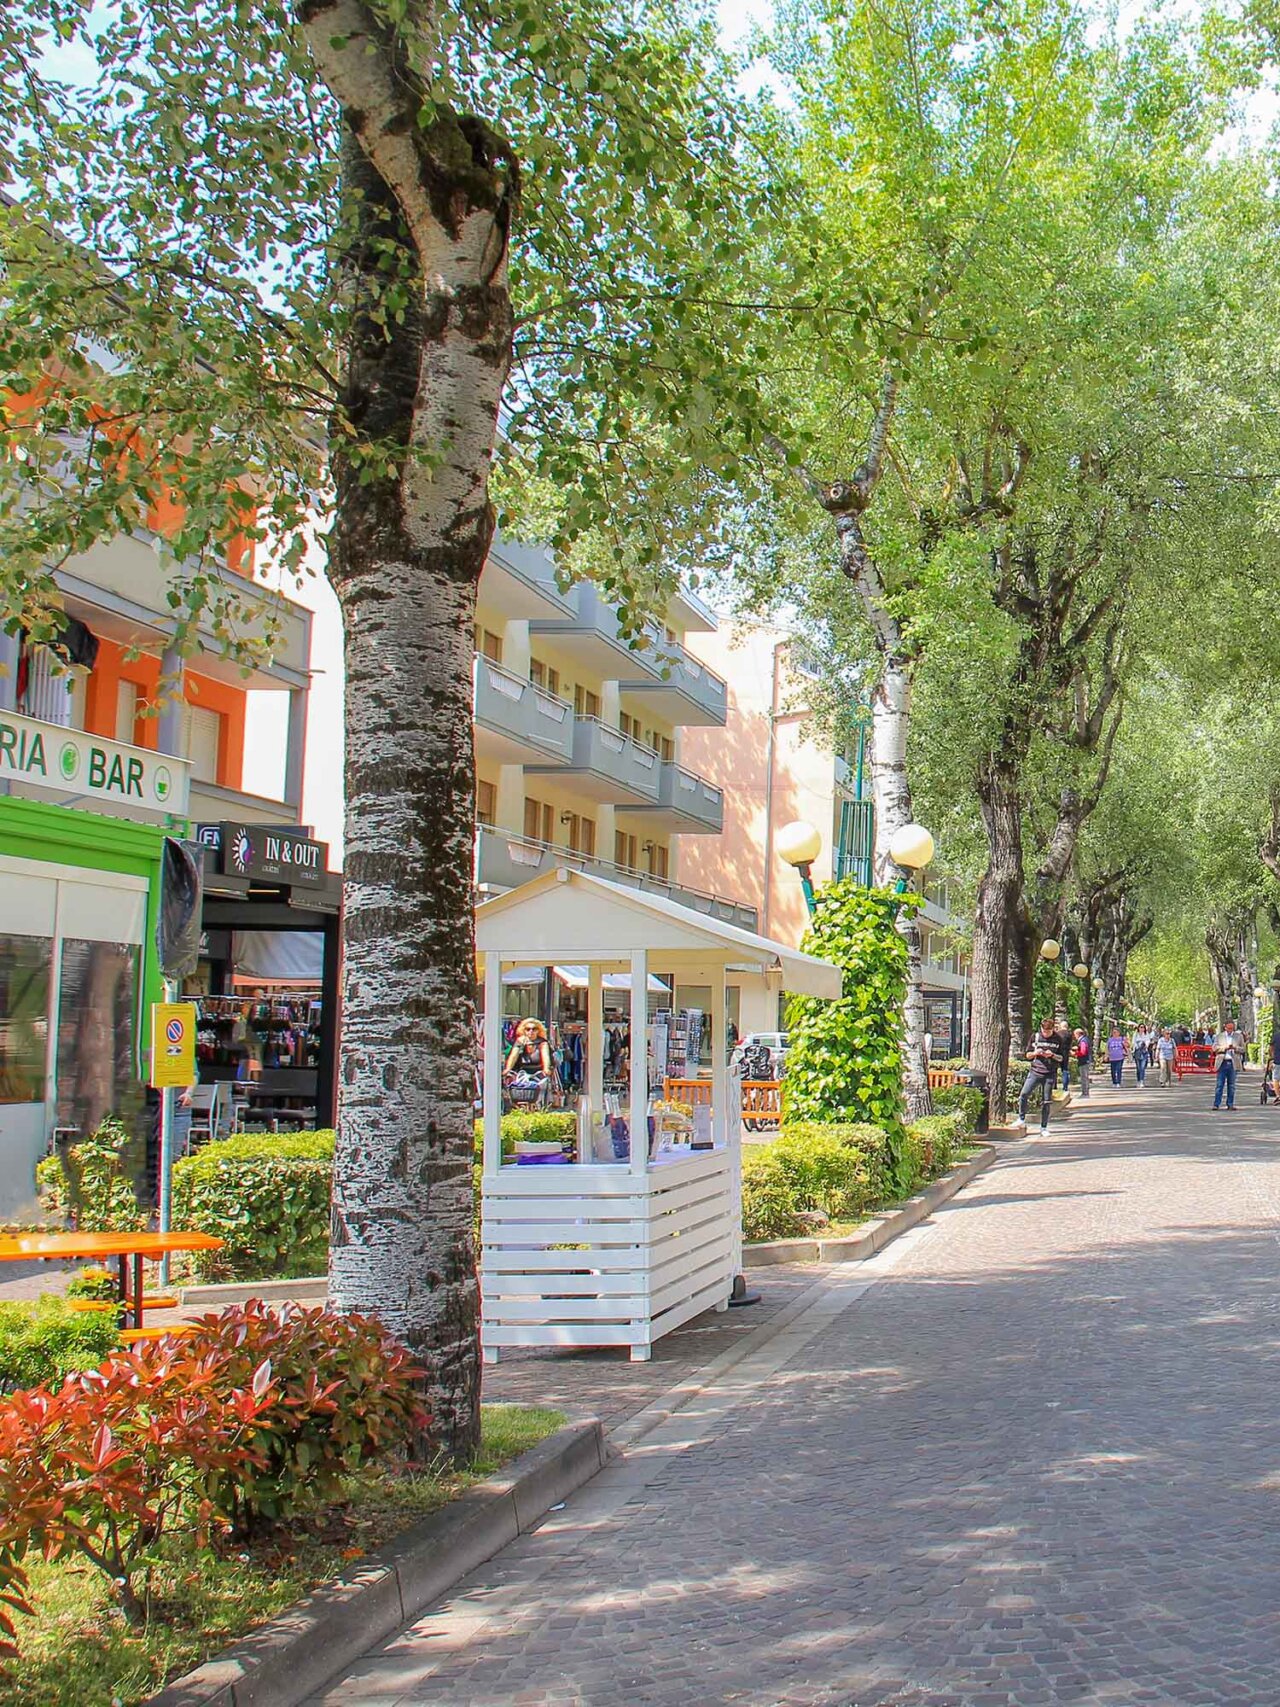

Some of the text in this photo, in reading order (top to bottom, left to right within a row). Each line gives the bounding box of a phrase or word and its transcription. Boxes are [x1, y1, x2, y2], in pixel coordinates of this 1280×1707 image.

[88, 747, 144, 798] BAR
[265, 836, 319, 868] IN & OUT
